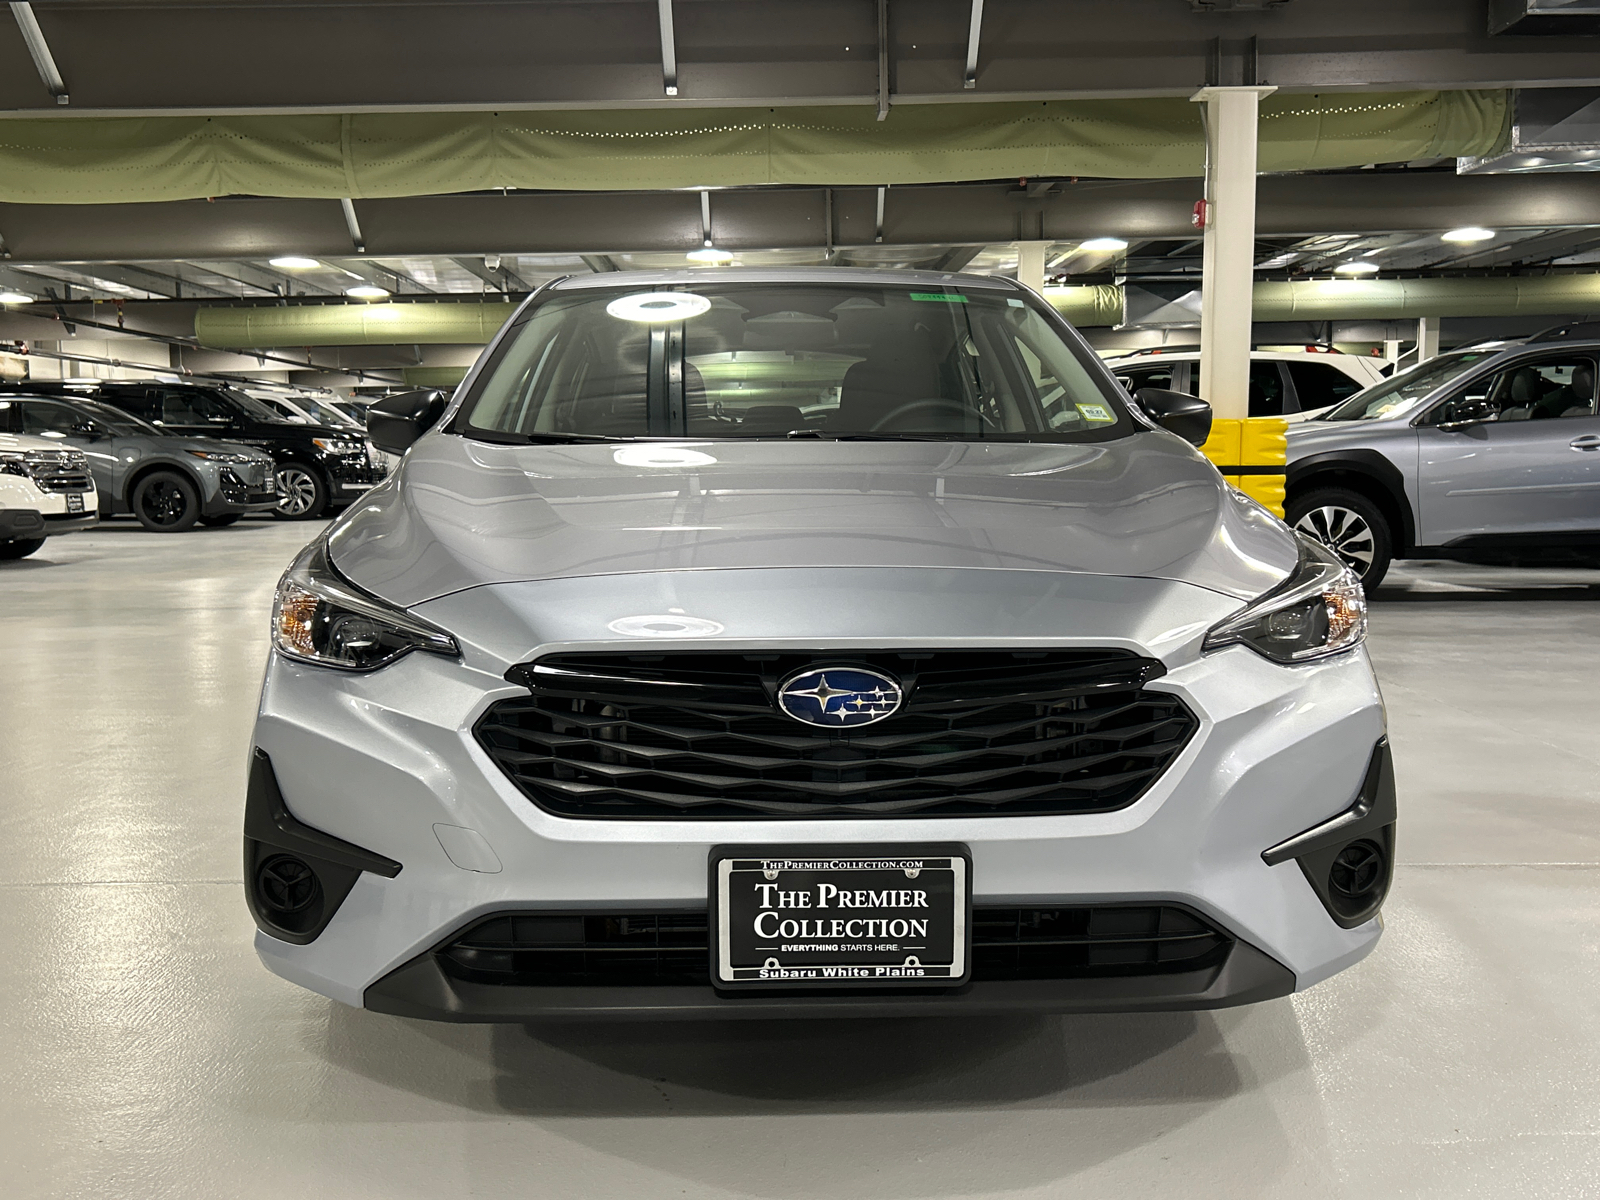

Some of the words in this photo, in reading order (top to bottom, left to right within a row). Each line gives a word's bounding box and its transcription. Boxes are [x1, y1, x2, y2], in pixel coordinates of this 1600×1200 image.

[761, 860, 923, 869] THEPREMIERCOLLECTION.COM
[754, 883, 811, 909] THE
[817, 883, 929, 908] PREMIER
[754, 911, 928, 938] COLLECTION
[759, 969, 816, 978] Subaru
[822, 968, 869, 977] White
[876, 967, 925, 976] Plains
